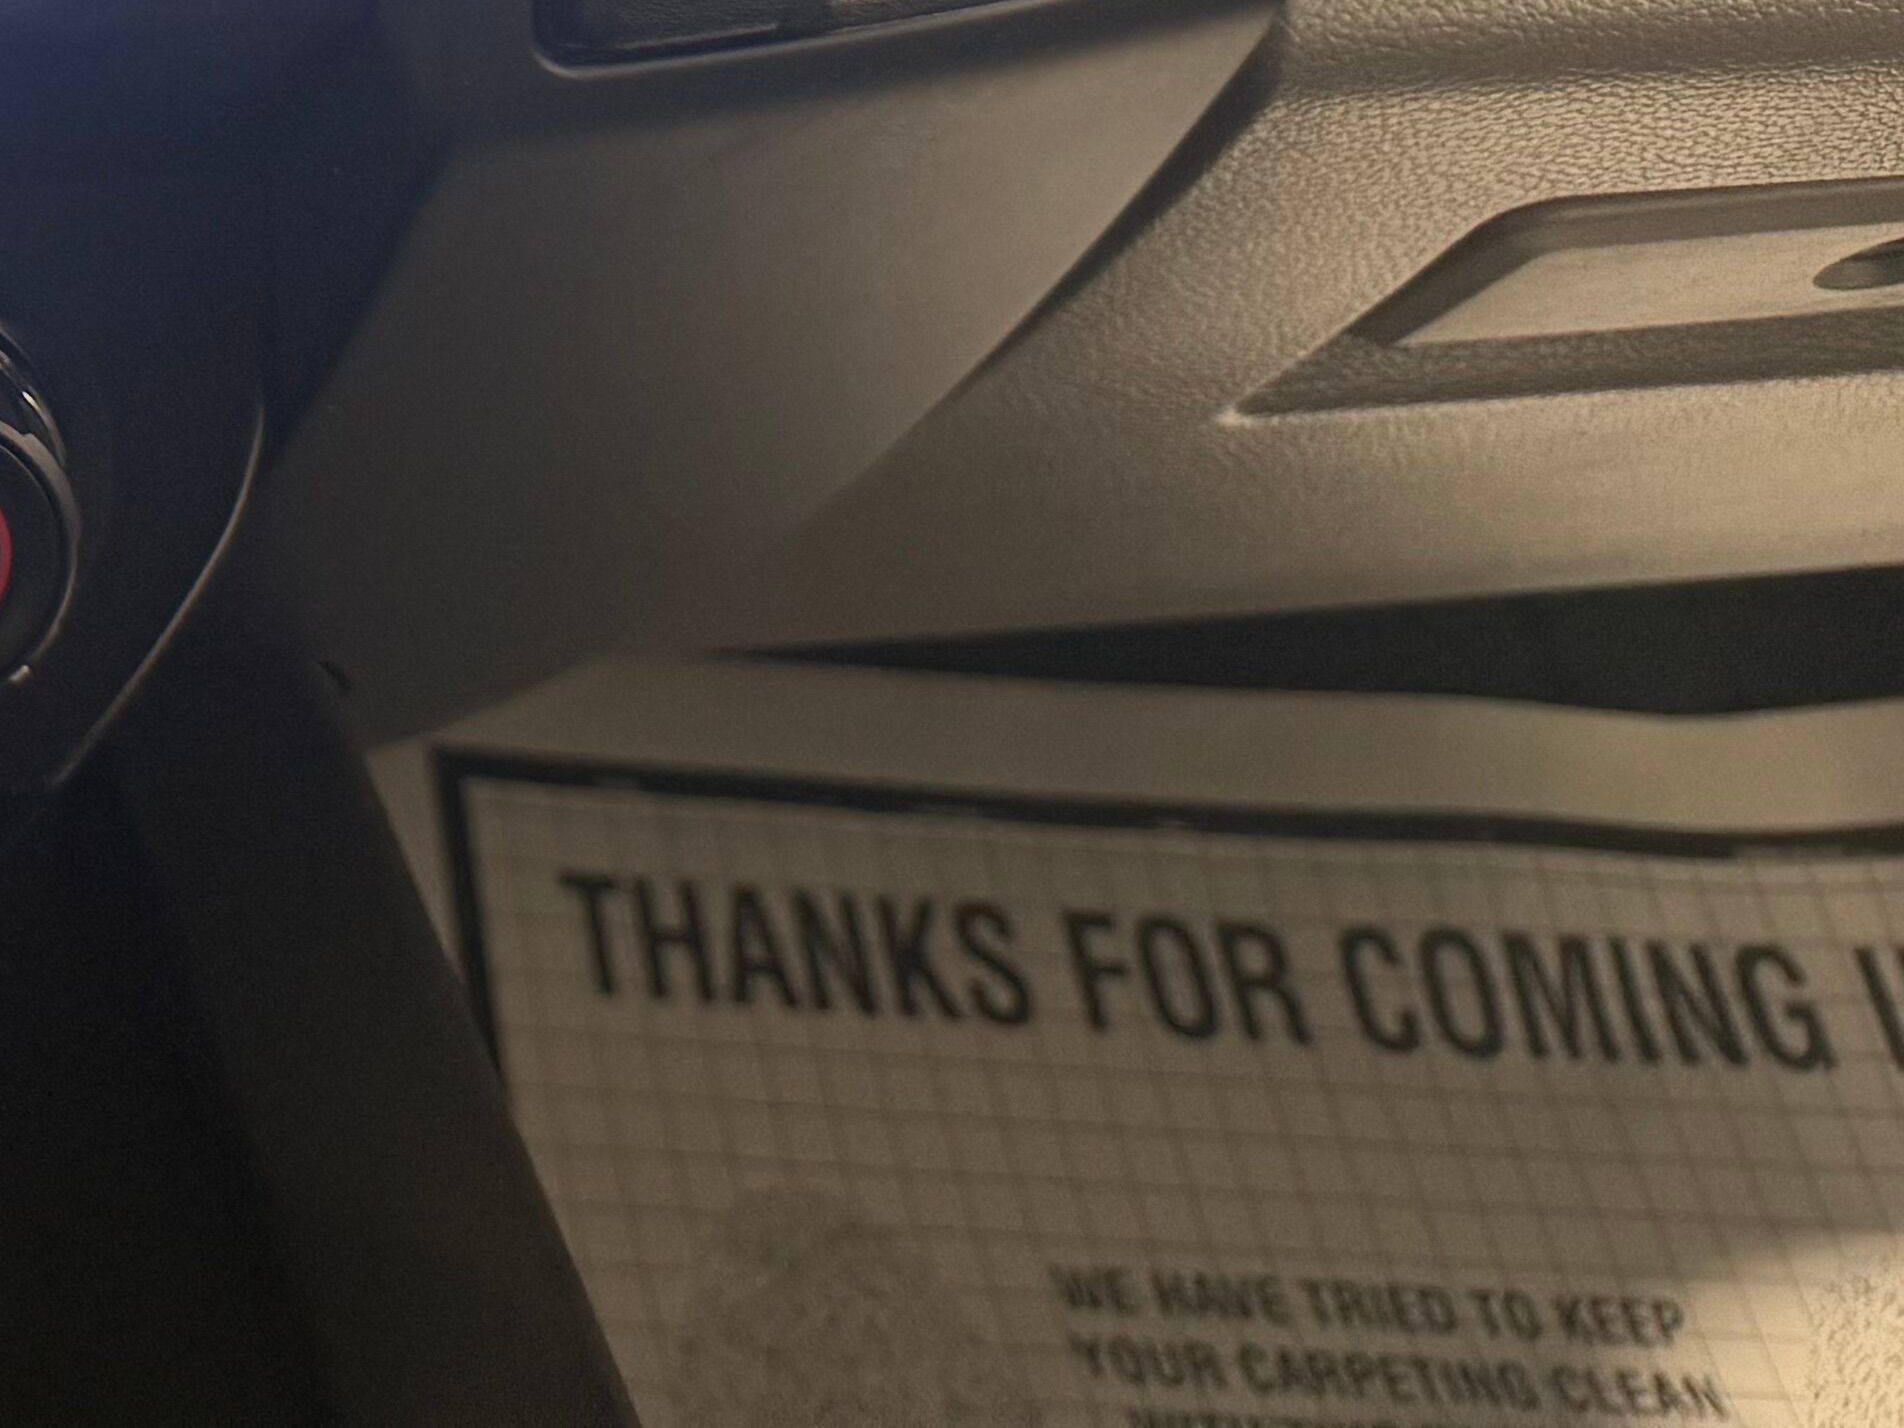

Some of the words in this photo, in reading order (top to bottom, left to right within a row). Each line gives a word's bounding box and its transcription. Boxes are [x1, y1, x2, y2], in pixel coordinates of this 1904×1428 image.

[556, 866, 1034, 1030] THANKS
[1061, 906, 1312, 1046] FOR
[1334, 923, 1837, 1074] COMING
[1050, 1262, 1137, 1316] WE
[1147, 1271, 1294, 1327] HAVE
[1298, 1277, 1460, 1335] TRIED
[1466, 1287, 1544, 1345] TO
[1550, 1293, 1685, 1349] KEEP
[1066, 1332, 1230, 1391] YOUR
[1236, 1342, 1541, 1411] CARPETING
[1544, 1361, 1730, 1421] CLEAN
